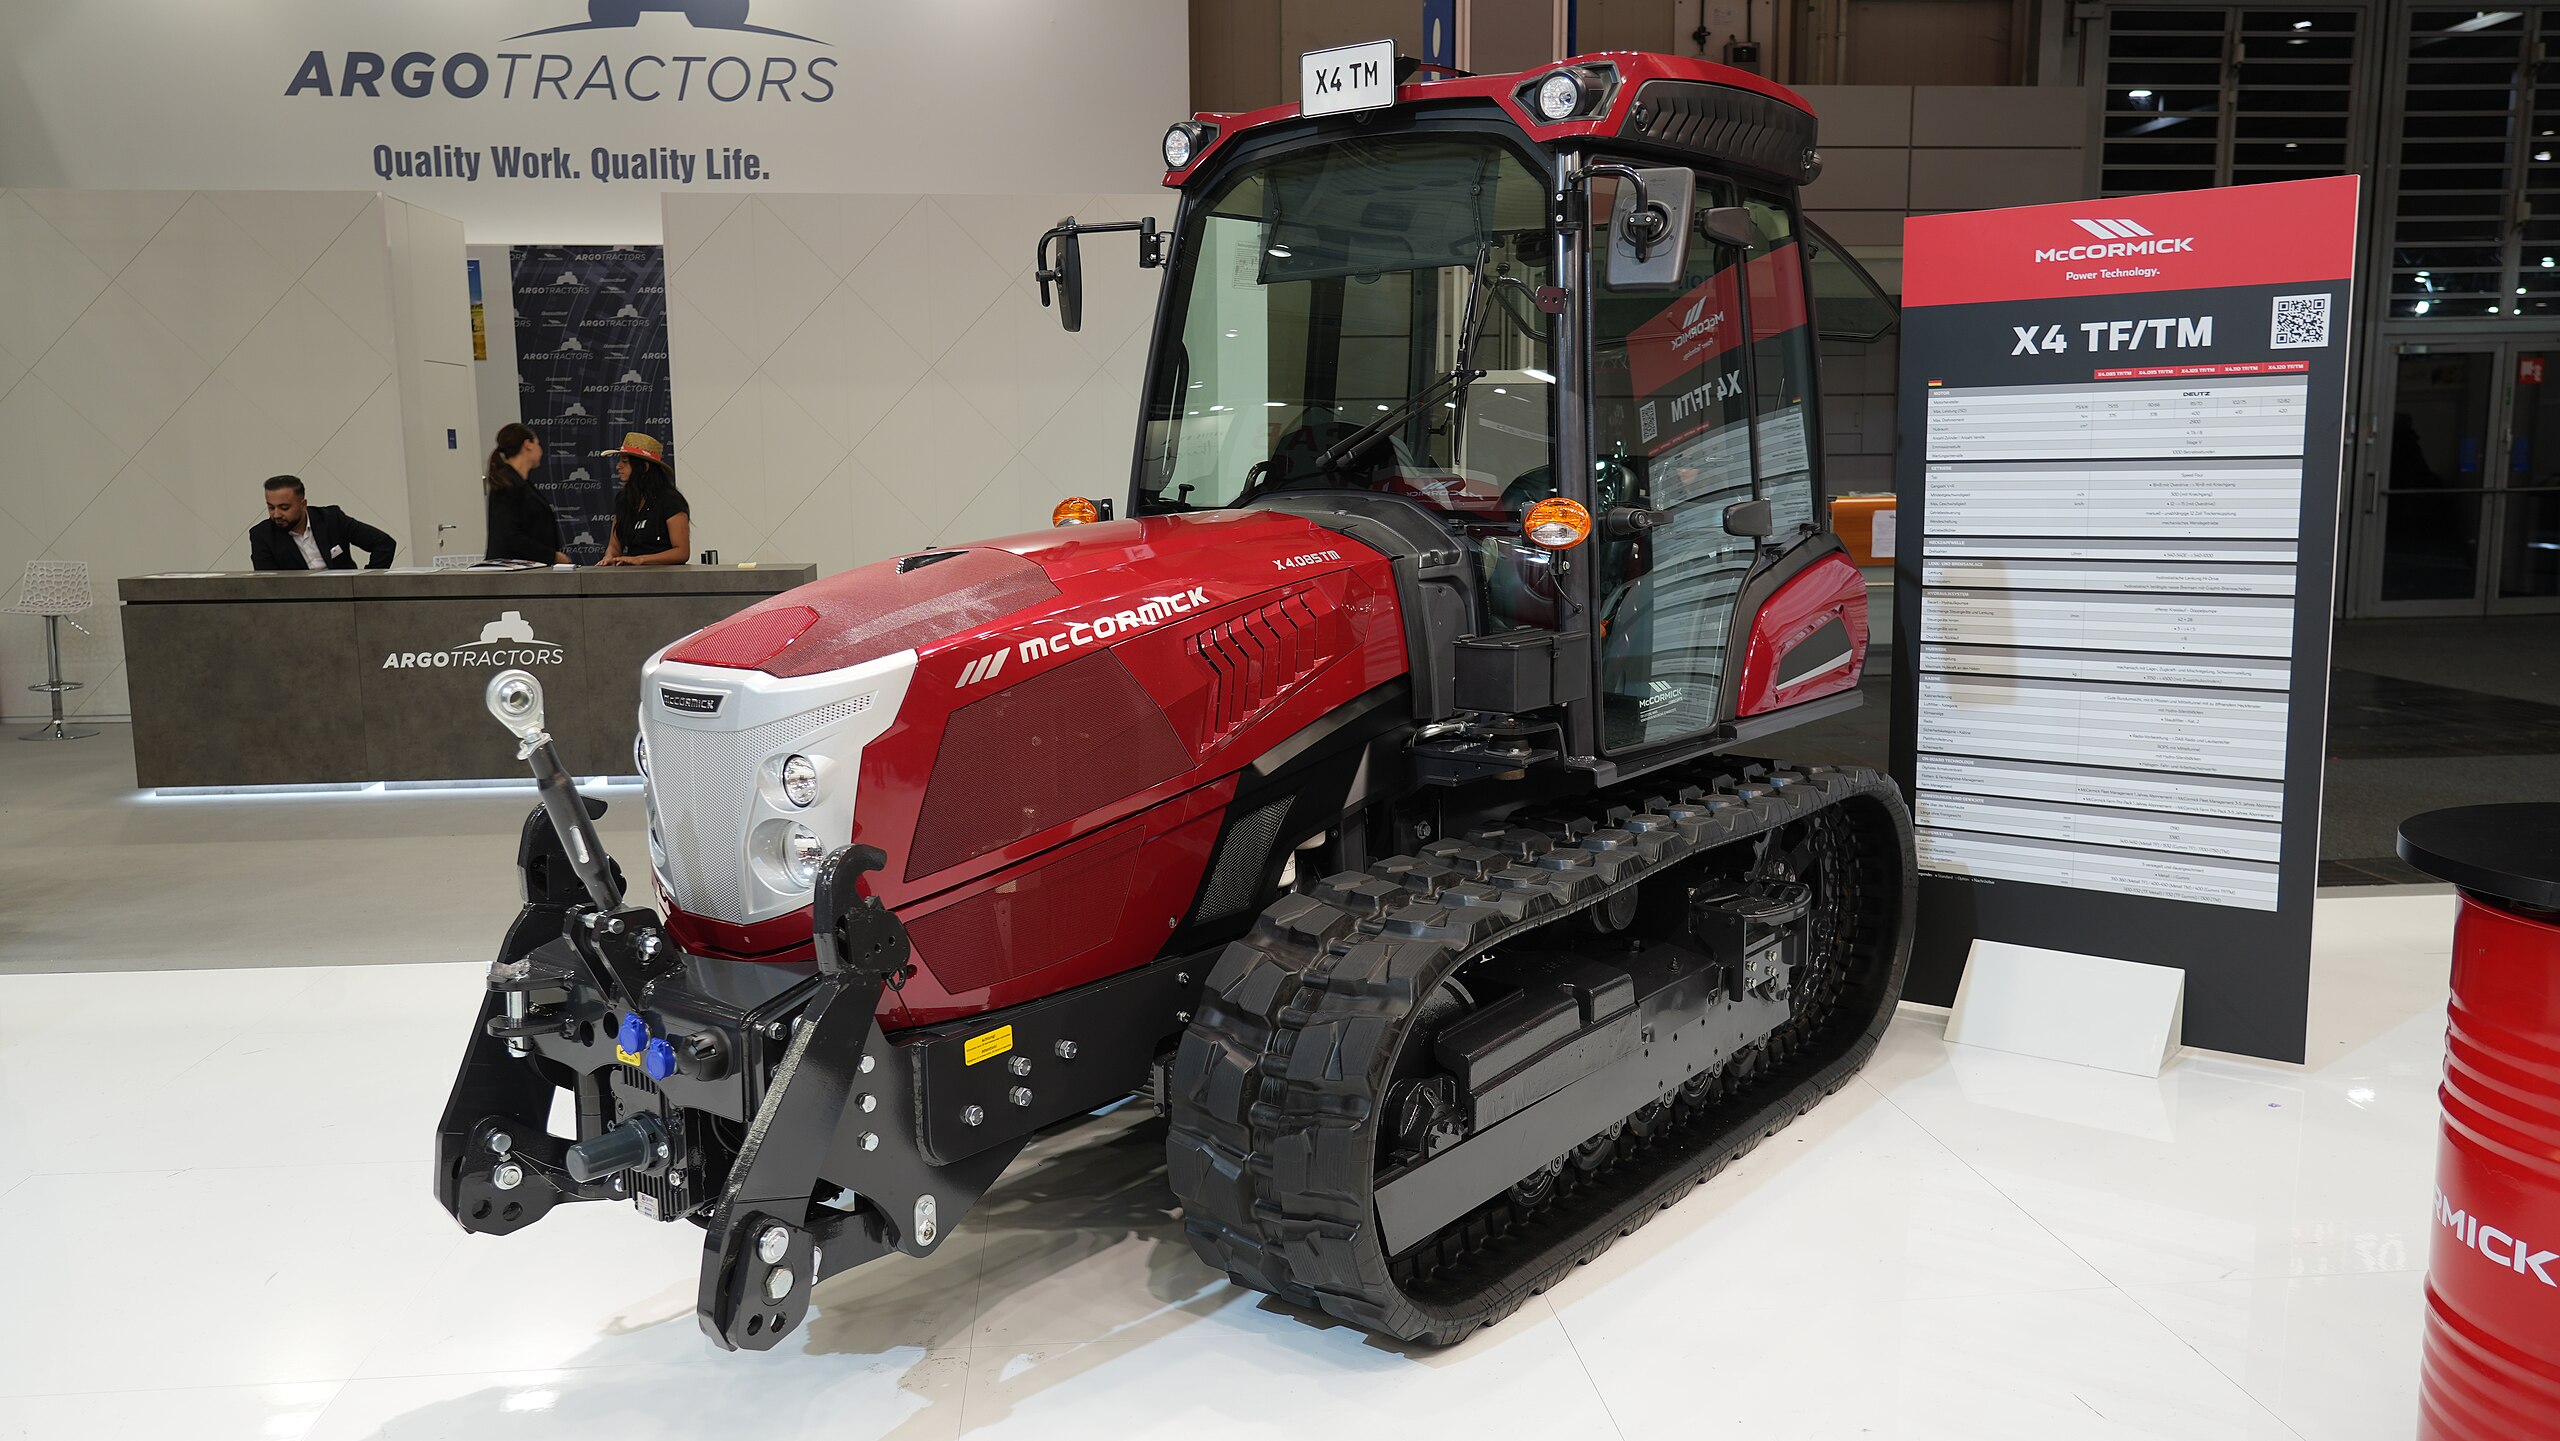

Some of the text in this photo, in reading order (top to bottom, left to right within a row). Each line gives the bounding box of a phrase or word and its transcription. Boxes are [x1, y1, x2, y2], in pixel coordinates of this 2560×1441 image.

[284, 50, 839, 103] ARGOTRACTORS
[1316, 61, 1378, 94] X4 TM
[373, 144, 770, 184] Quality Work. Quality Life.
[2035, 237, 2195, 263] McCORMICK
[2065, 267, 2161, 281] Power Technology.
[2011, 316, 2213, 356] X4 TF/TM
[382, 649, 564, 669] ARGOTRACTORS
[1639, 688, 1682, 708] McCORMICK
